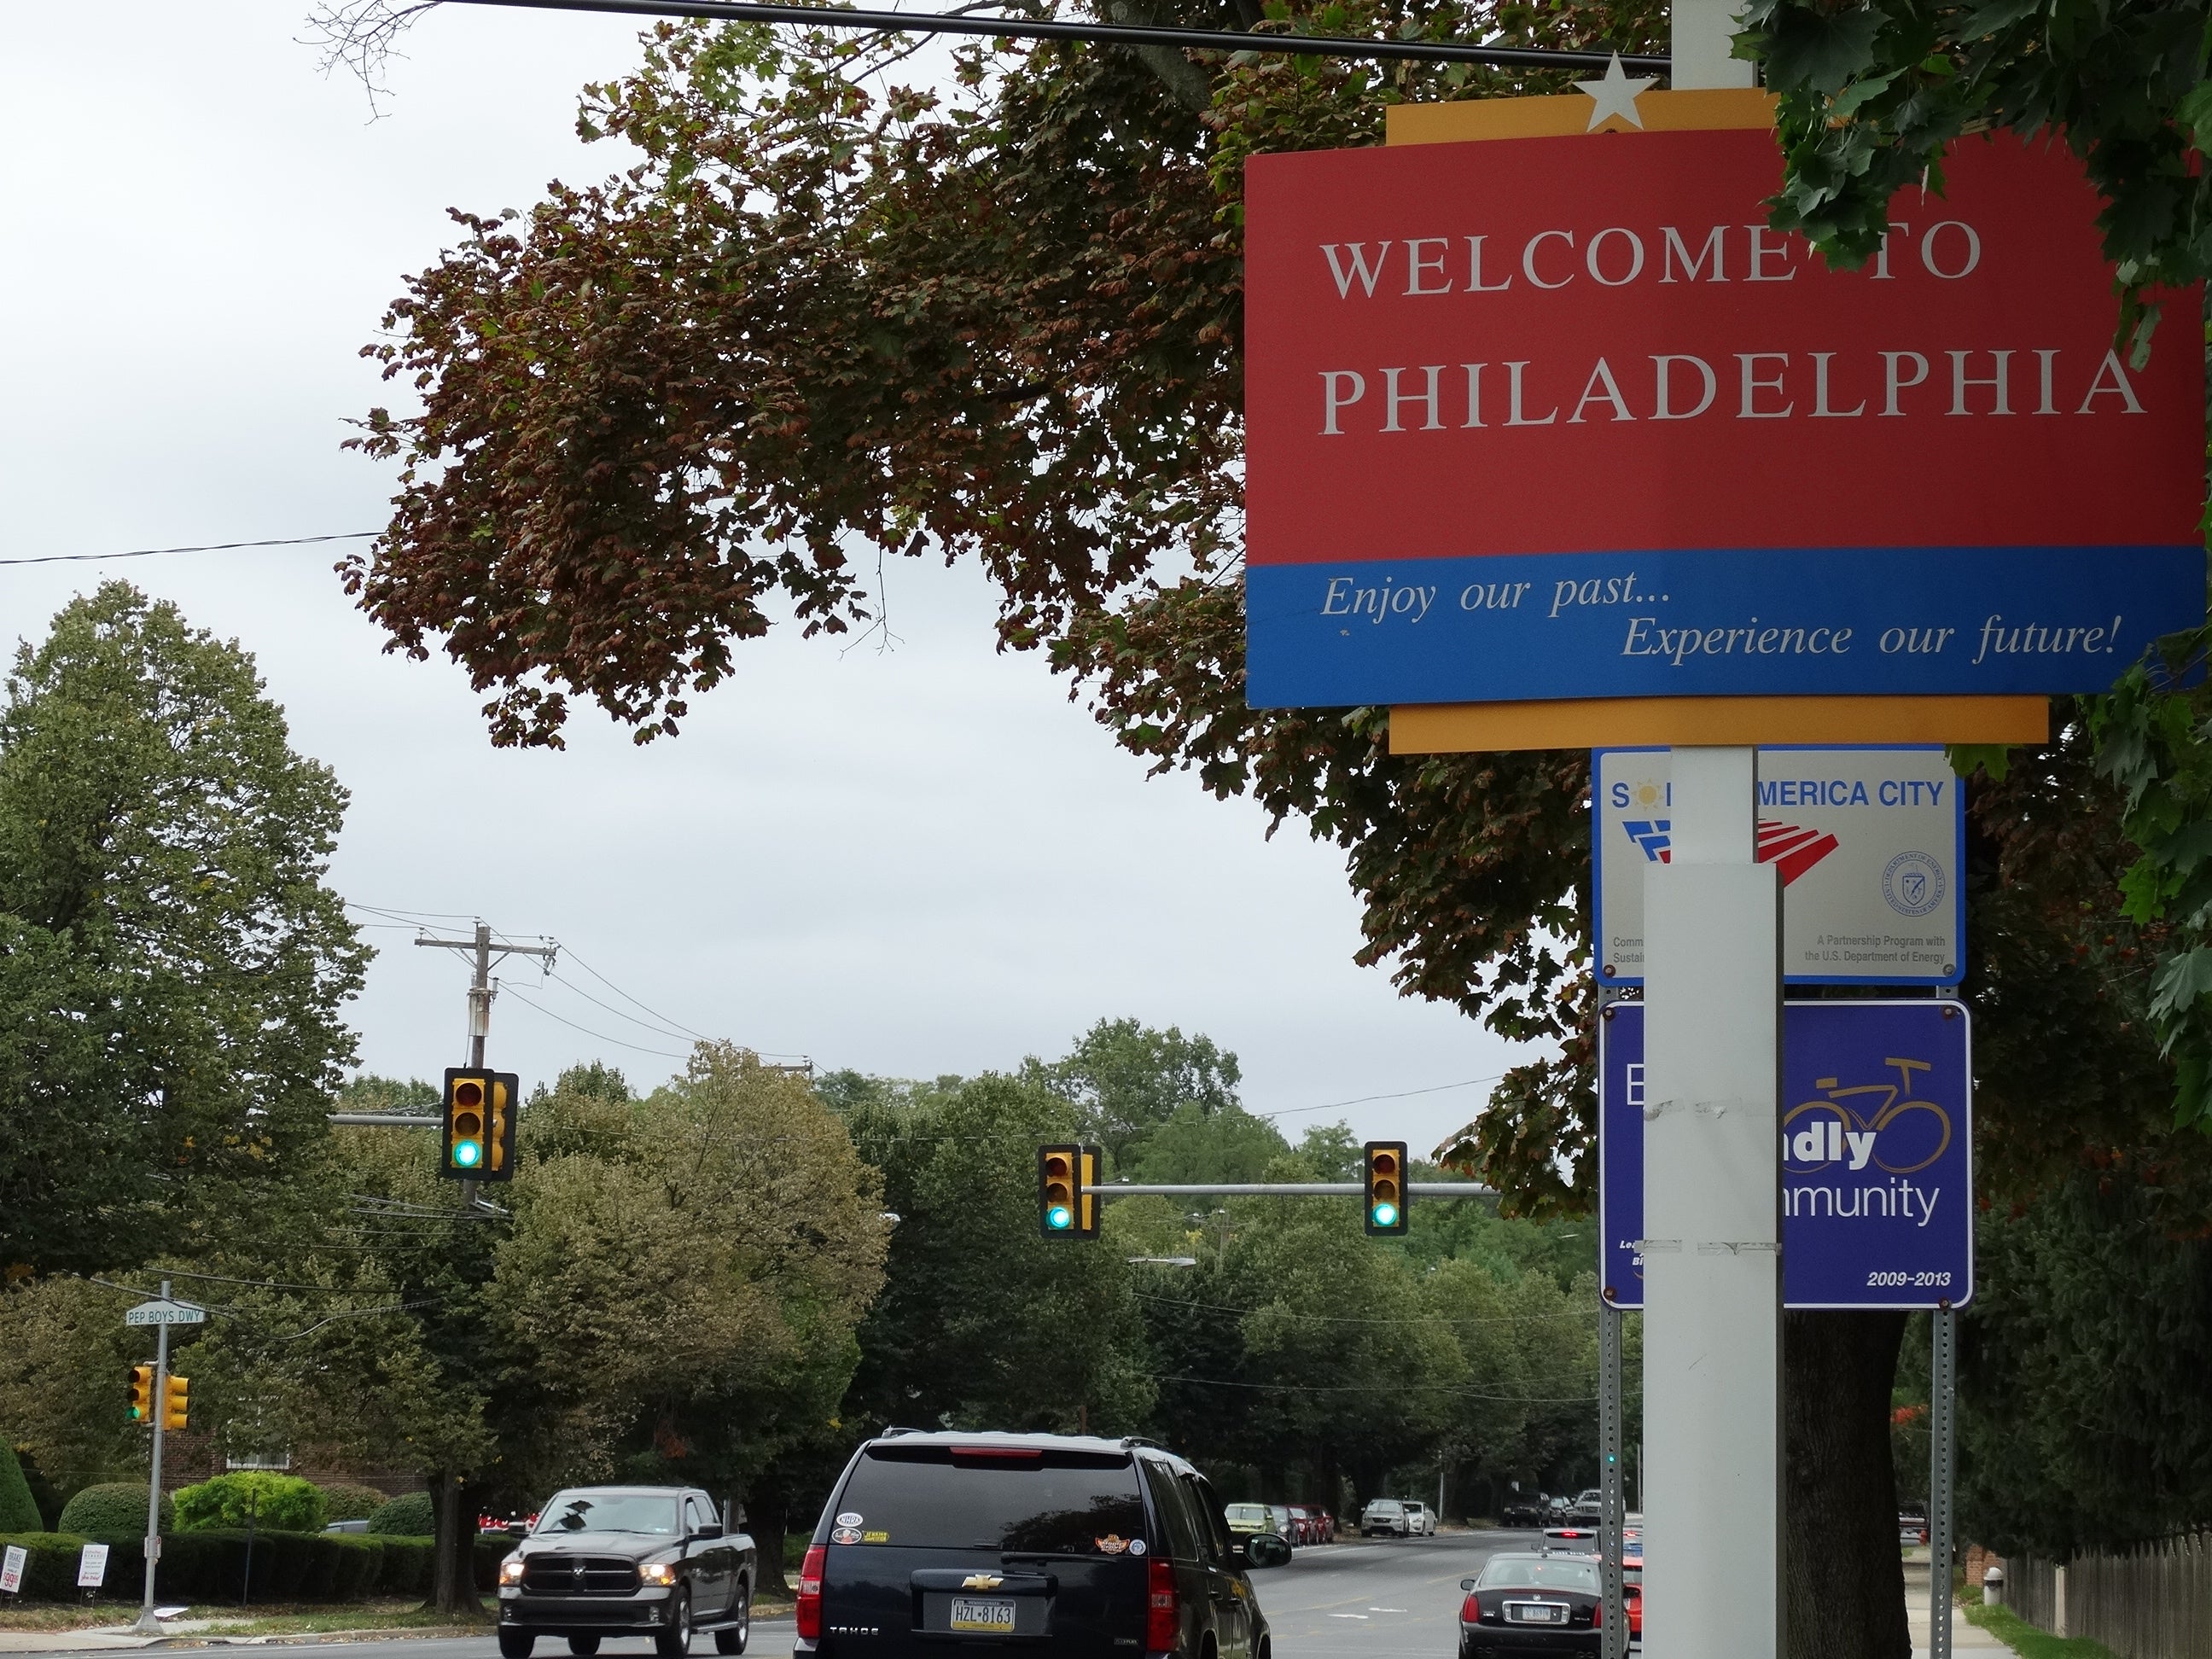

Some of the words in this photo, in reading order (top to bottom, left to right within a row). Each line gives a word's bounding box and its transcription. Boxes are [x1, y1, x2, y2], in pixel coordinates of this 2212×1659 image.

[1319, 224, 1797, 300] WELCOME
[1869, 219, 1981, 280] TO
[1318, 349, 2147, 437] PHILADELPHIA
[1320, 576, 1438, 623] Enjoy
[1460, 583, 1532, 611] our
[1548, 572, 1671, 618] past...
[1620, 616, 1852, 667] Experience
[1879, 626, 1954, 655] our
[1972, 614, 2122, 665] future!
[1757, 780, 1869, 806] MERICA
[1878, 780, 1944, 806] CITY
[1817, 934, 1825, 946] A
[1827, 934, 1881, 947] Partnership
[1883, 935, 1924, 948] Program
[1926, 935, 1946, 946] with
[1805, 951, 1819, 961] the
[1822, 951, 1841, 961] U.S.
[1844, 951, 1898, 963] Department
[1901, 952, 1910, 962] of
[1912, 952, 1945, 964] Energy
[1866, 1272, 1952, 1286] 2009-2013
[128, 1312, 145, 1324] PEP
[148, 1310, 174, 1323] BOYS
[178, 1310, 201, 1322] DWY
[830, 1626, 879, 1636] TAHOE
